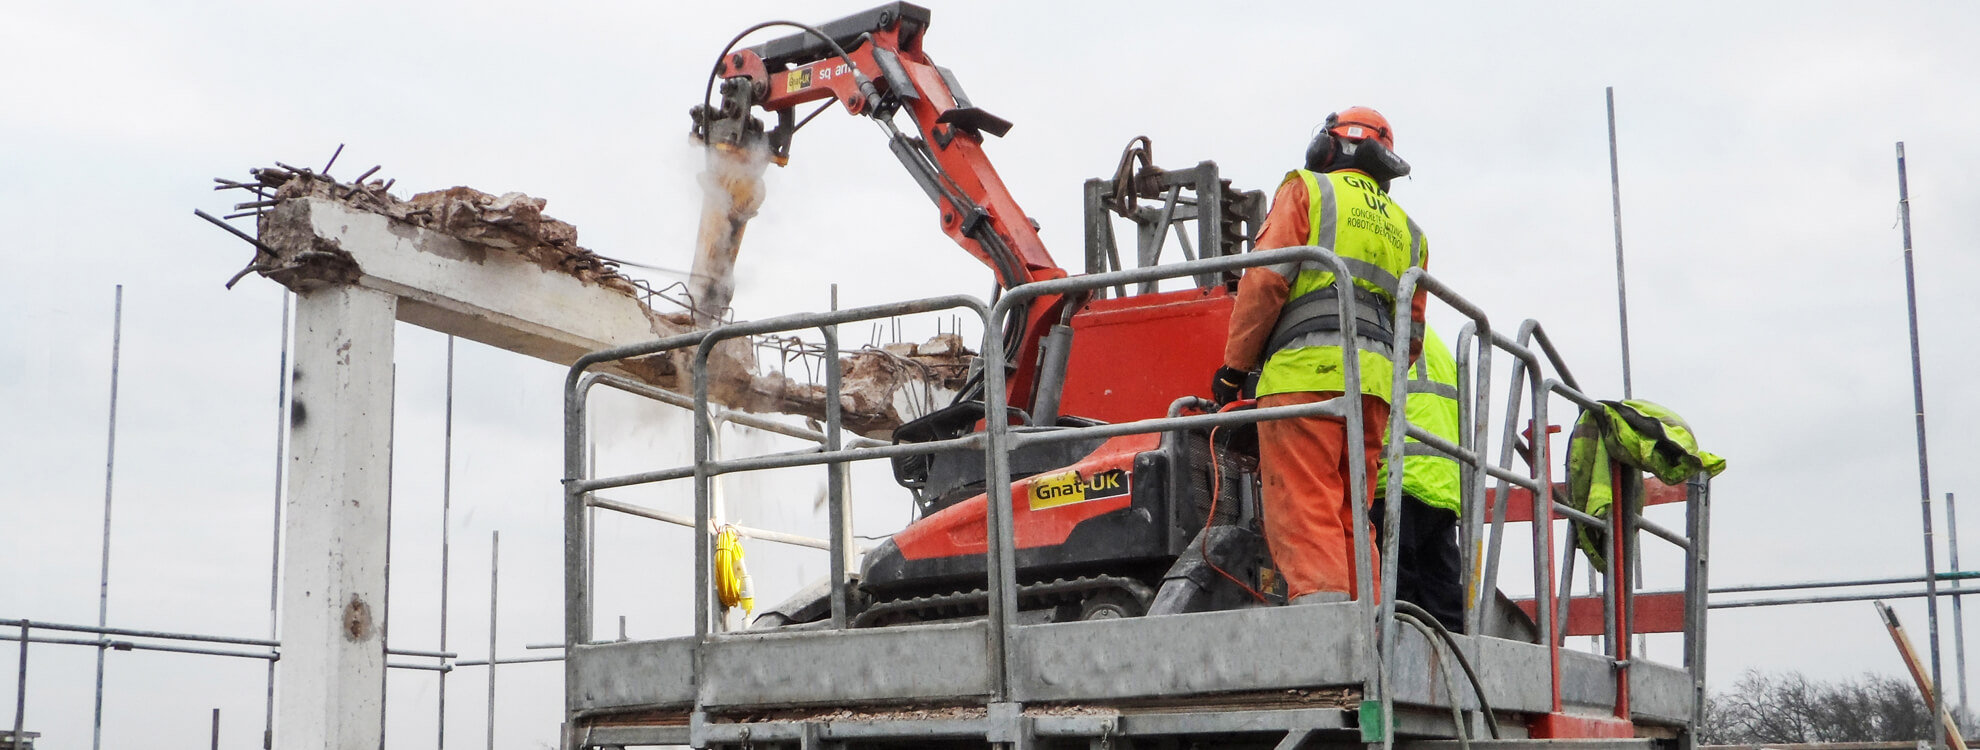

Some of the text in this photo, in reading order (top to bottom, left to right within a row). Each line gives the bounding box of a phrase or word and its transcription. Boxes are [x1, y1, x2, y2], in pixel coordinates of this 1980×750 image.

[1364, 193, 1390, 218] UK
[1347, 217, 1374, 232] ROBOTIC
[1351, 207, 1403, 239] CONCRETE UTTING
[1036, 473, 1120, 500] Gnat-UK
